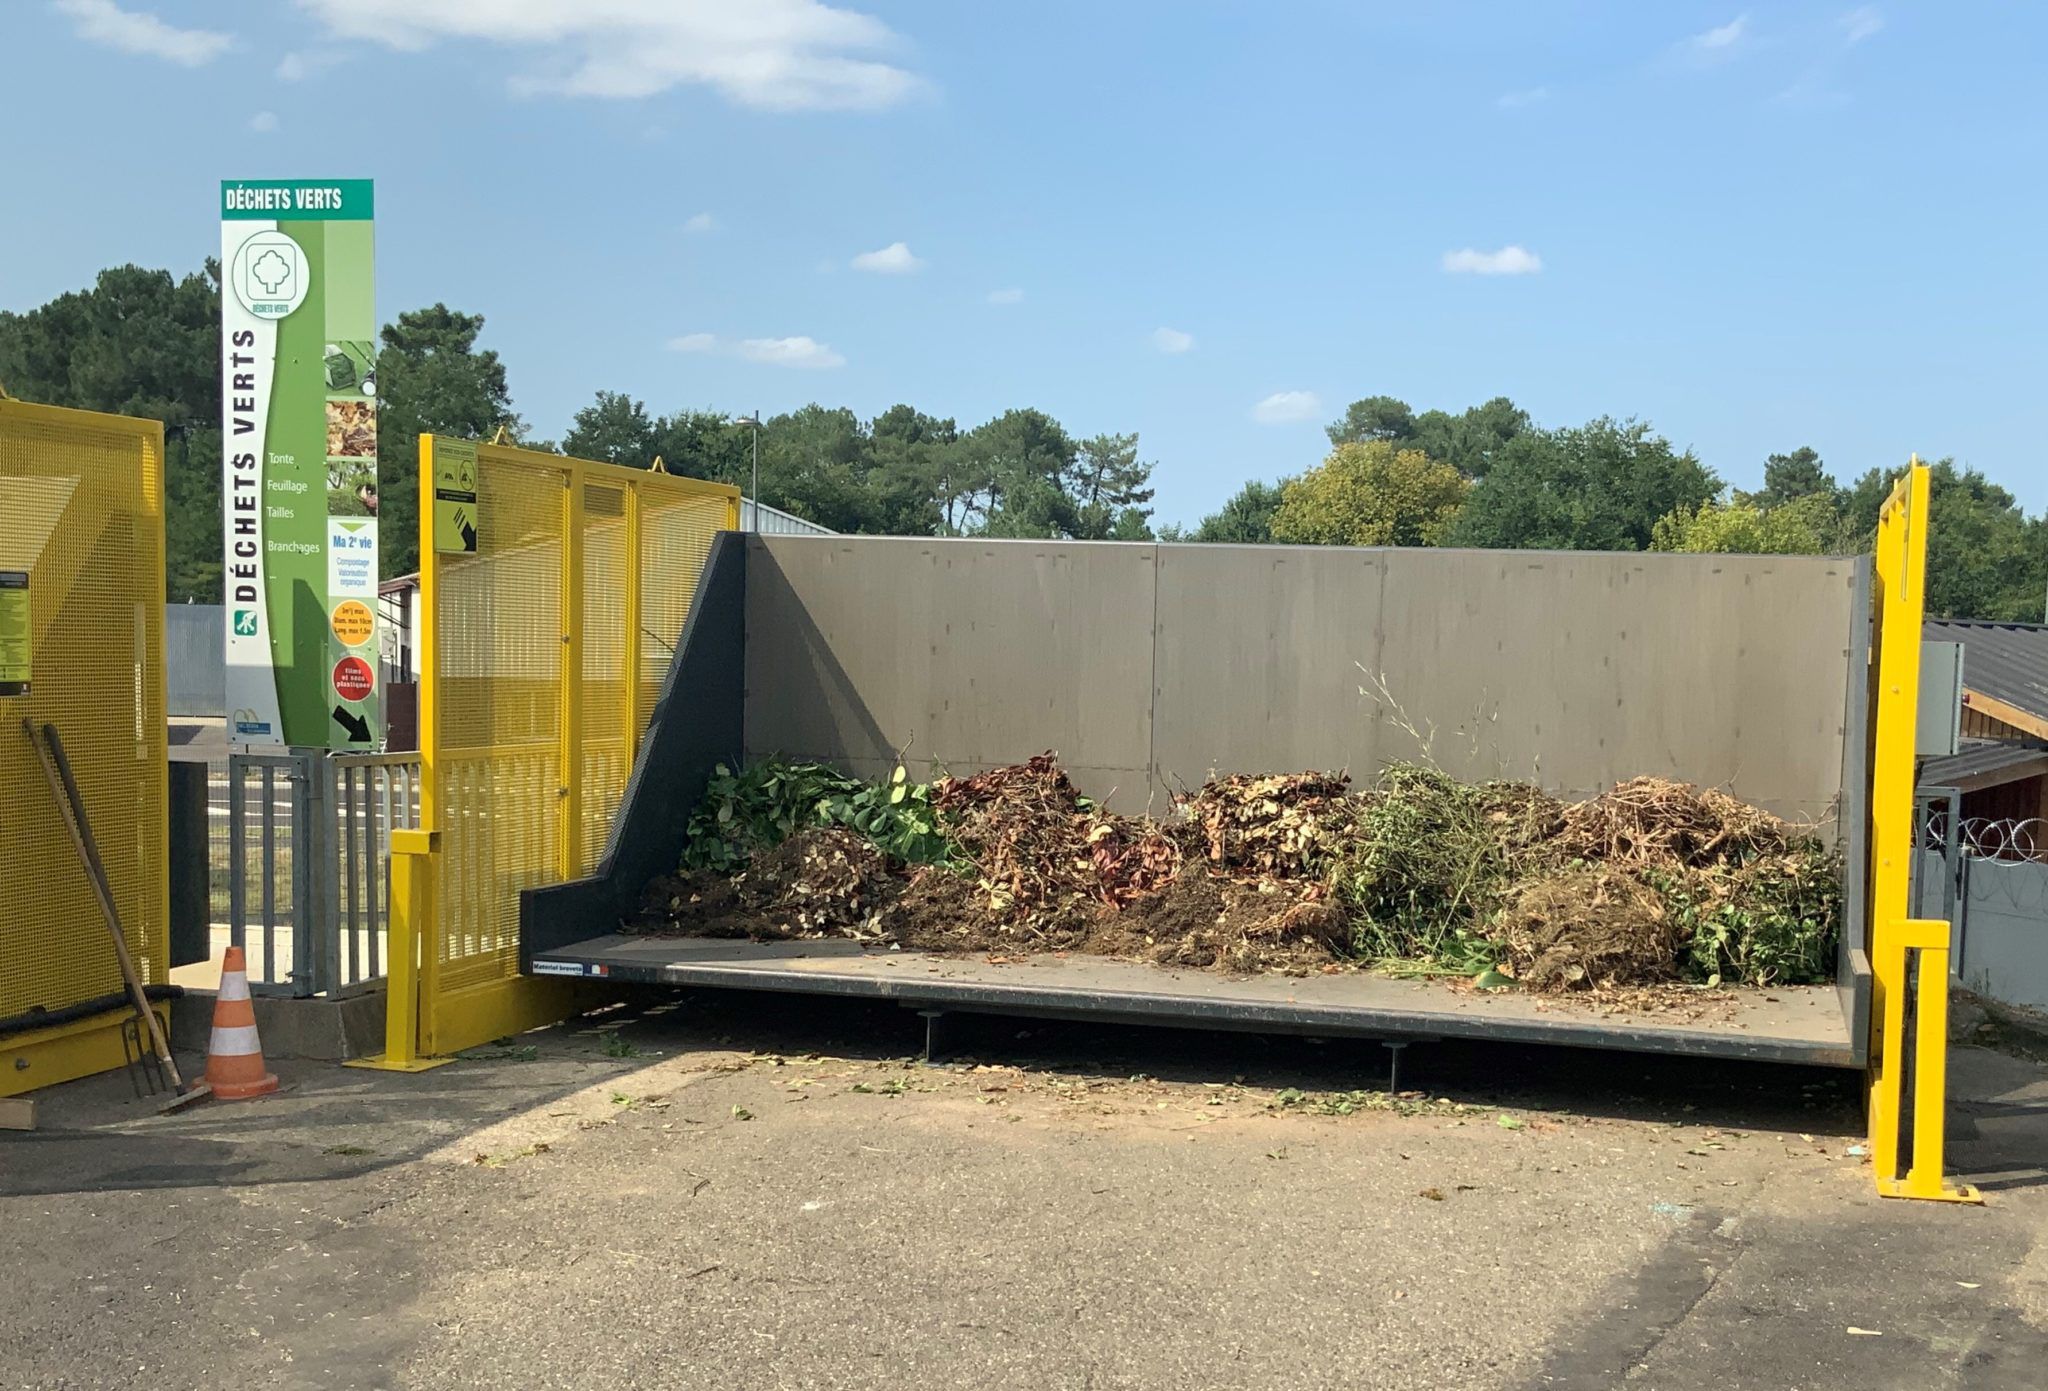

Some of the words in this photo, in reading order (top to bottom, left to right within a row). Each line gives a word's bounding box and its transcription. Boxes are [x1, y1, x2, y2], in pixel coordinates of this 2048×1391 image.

[226, 184, 291, 210] DÉCHETS
[295, 188, 342, 210] VERTS
[274, 304, 289, 313] VERTS
[232, 330, 255, 436] VERTS
[268, 452, 295, 465] Tonte
[267, 480, 308, 495] Feuillage
[266, 506, 295, 518] Tailles
[229, 453, 257, 603] DÉCHETS
[268, 540, 320, 556] Branchages
[333, 535, 346, 548] Ma
[359, 536, 372, 549] vie
[336, 557, 370, 568] Compostage
